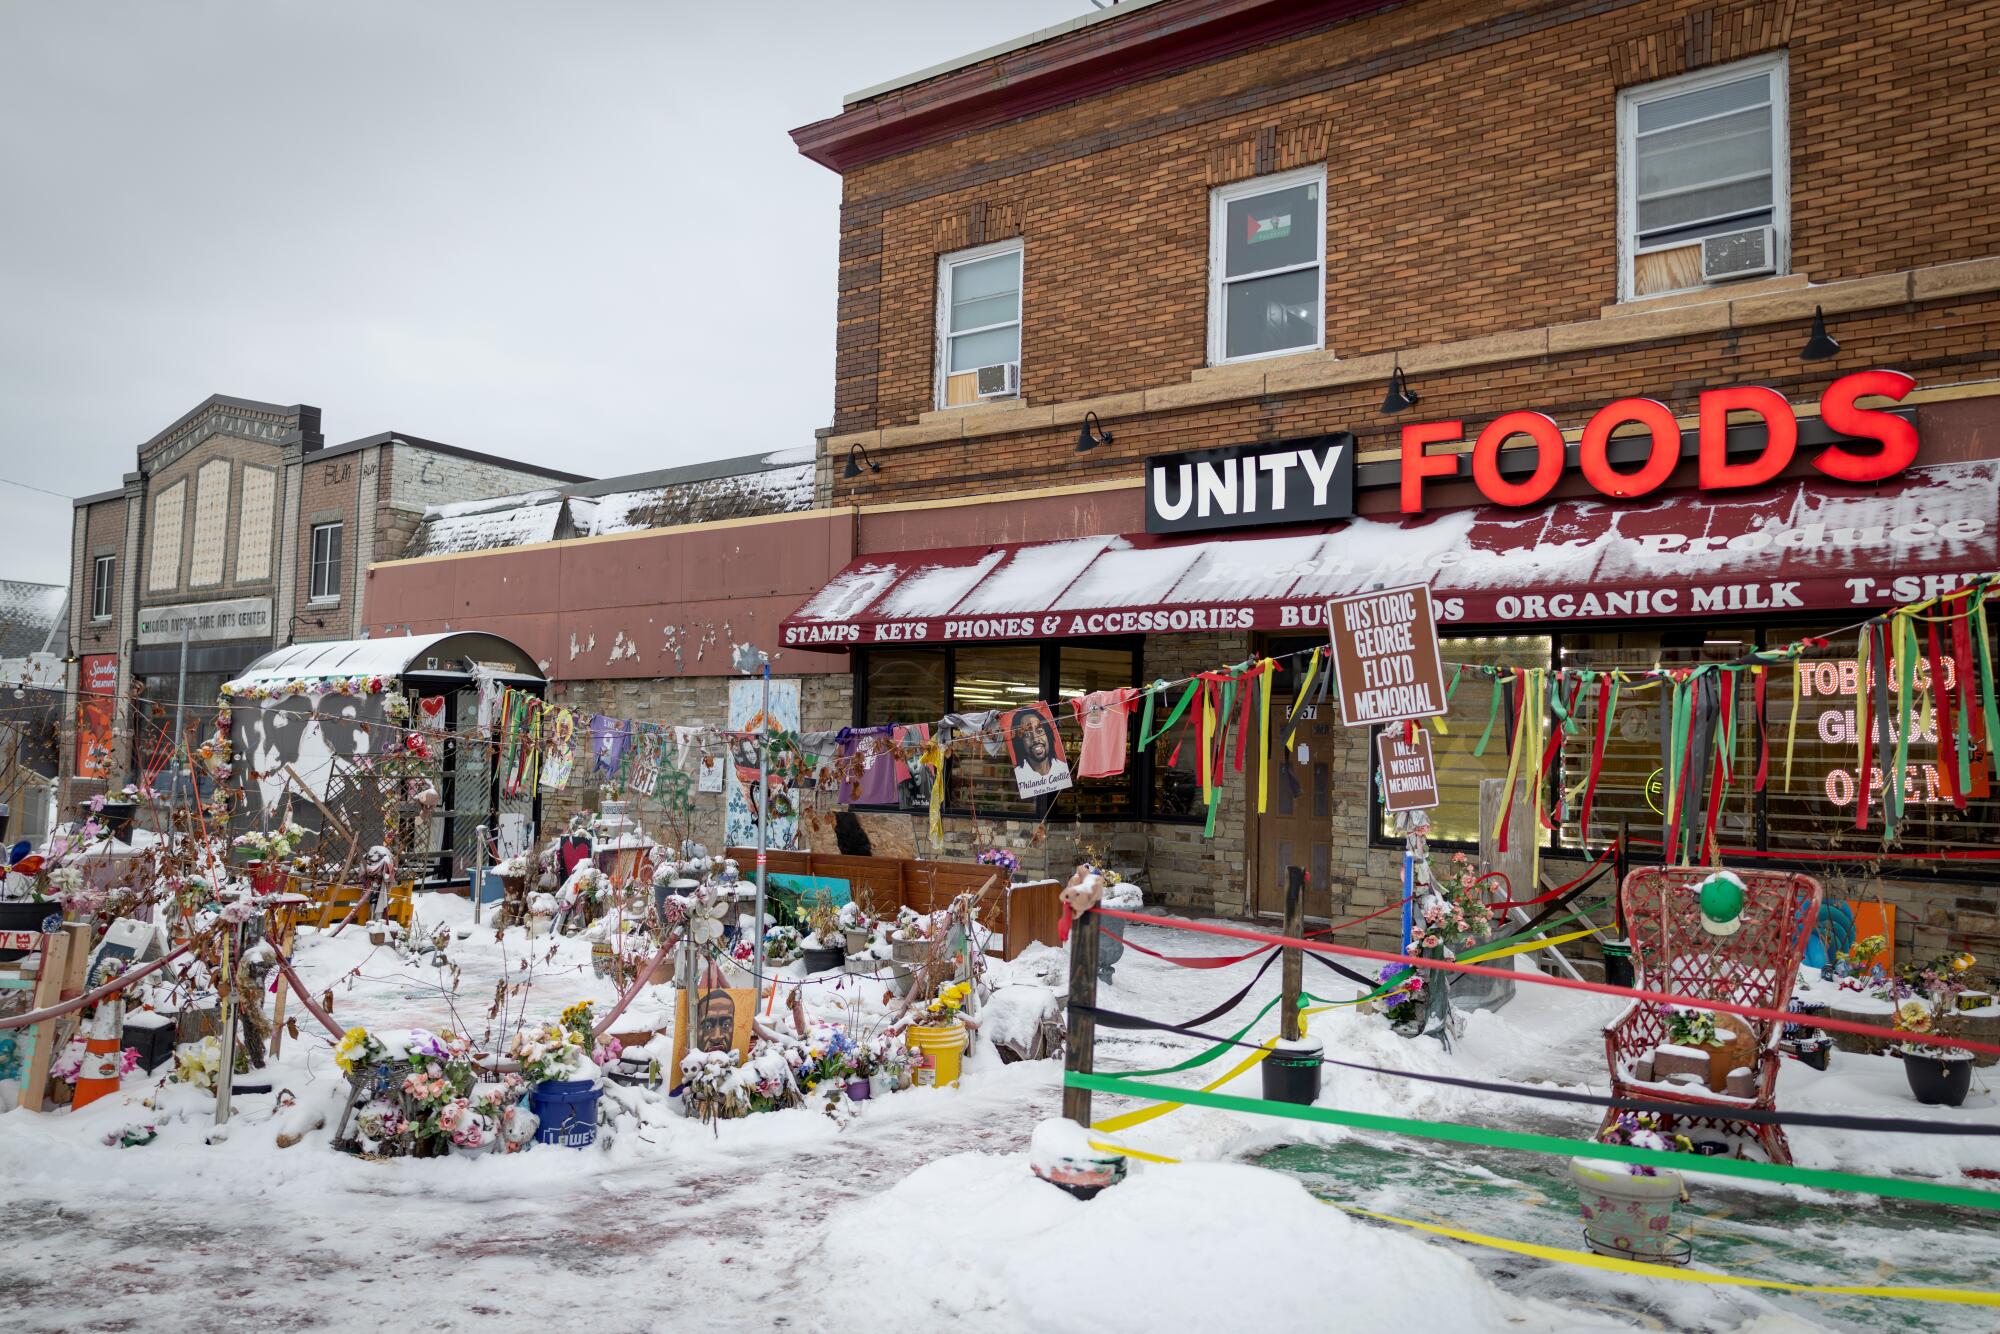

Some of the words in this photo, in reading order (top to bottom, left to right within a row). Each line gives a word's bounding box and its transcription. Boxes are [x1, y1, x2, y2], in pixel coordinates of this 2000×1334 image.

[1400, 369, 1919, 514] FOODS
[1153, 445, 1344, 521] UNITY
[1638, 518, 1986, 557] Produce
[141, 619, 169, 634] CHICAGO
[217, 613, 236, 628] ARTS
[238, 610, 267, 627] CENTER
[785, 624, 860, 644] STAMPS
[874, 622, 928, 641] KEYS
[944, 617, 1036, 639] PHONES
[1041, 616, 1061, 635] &
[1068, 607, 1255, 635] ACCESSORIES
[1495, 588, 1679, 620] ORGANIC
[1690, 581, 1804, 612] MILK
[1342, 592, 1417, 632] HISTORIC
[1354, 622, 1416, 659] GEORGE
[1362, 654, 1415, 689] FLOYD
[1354, 682, 1436, 721] MEMORIAL
[1018, 777, 1046, 790] Philando
[1048, 771, 1071, 785] Castile
[1388, 774, 1434, 794] MEMORIAL
[1390, 756, 1425, 775] WRIGHT
